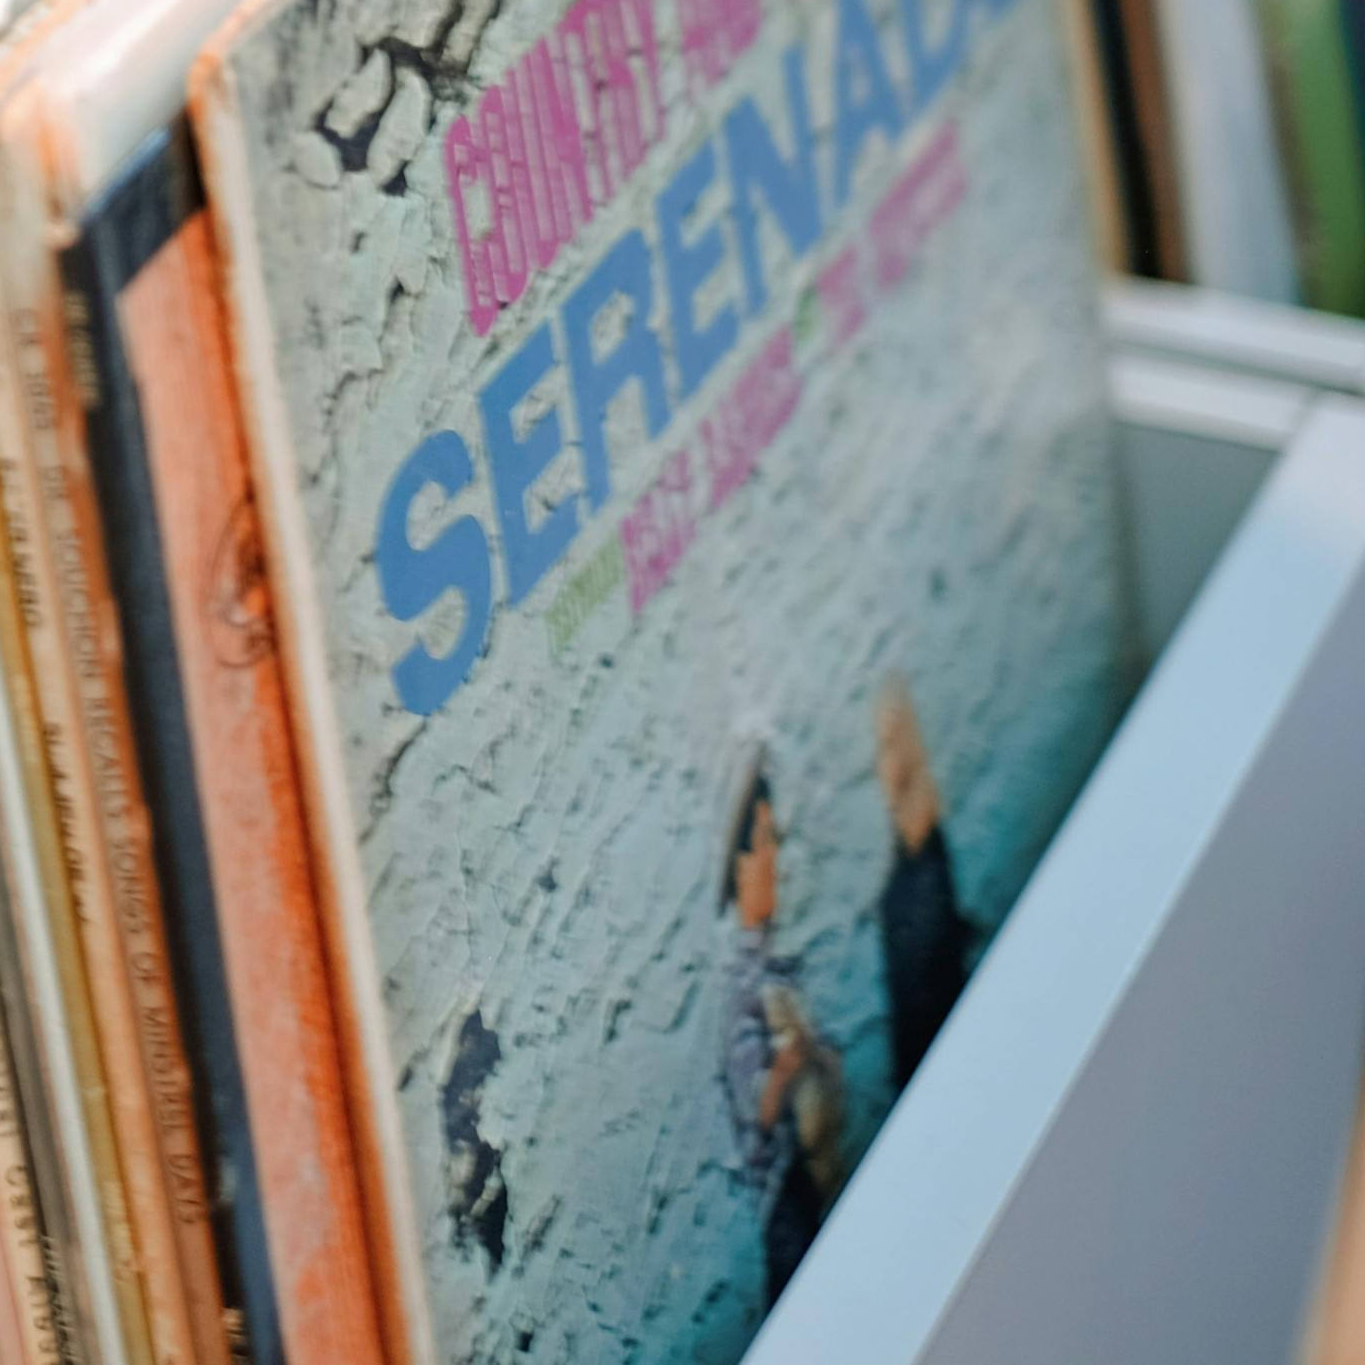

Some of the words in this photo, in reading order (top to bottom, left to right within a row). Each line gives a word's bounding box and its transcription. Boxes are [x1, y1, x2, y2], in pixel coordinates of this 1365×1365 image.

[113, 833, 151, 937] SONGS
[132, 948, 162, 990] OF
[144, 1001, 186, 1138] MINSTREL
[170, 1149, 203, 1226] DAYS
[6, 1162, 41, 1251] Cast
[27, 1271, 60, 1363] Albu
